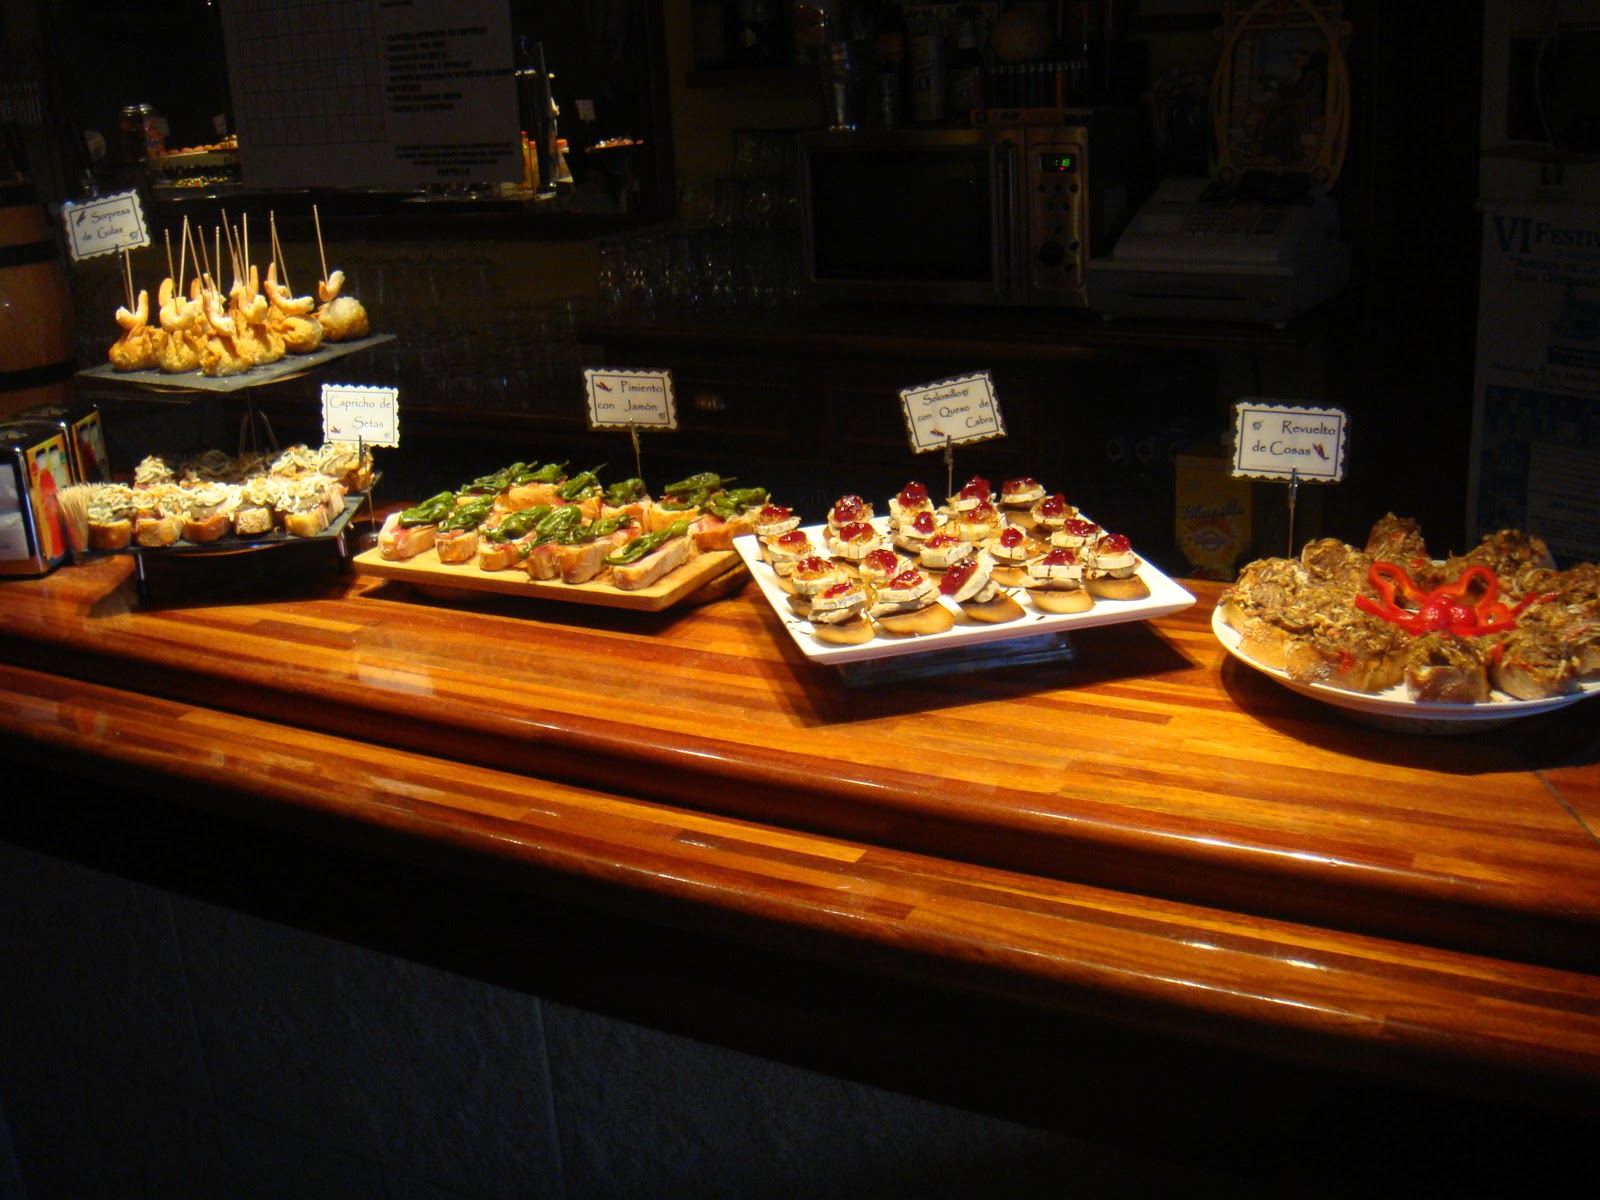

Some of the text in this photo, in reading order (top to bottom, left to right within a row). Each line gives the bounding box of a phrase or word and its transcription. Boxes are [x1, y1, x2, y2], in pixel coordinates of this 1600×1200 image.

[91, 208, 131, 224] Sorpresa
[82, 225, 124, 241] de Gulas
[1494, 215, 1532, 254] VI
[620, 380, 664, 393] Pimiento
[329, 395, 392, 412] Capricho de
[923, 388, 961, 406] Solomillo
[597, 400, 657, 412] con Jamón
[917, 399, 990, 422] con Queso de
[352, 416, 384, 430] Setas
[965, 415, 994, 428] Cabra
[1281, 420, 1336, 436] Revuelto
[1252, 440, 1312, 456] de Cosas
